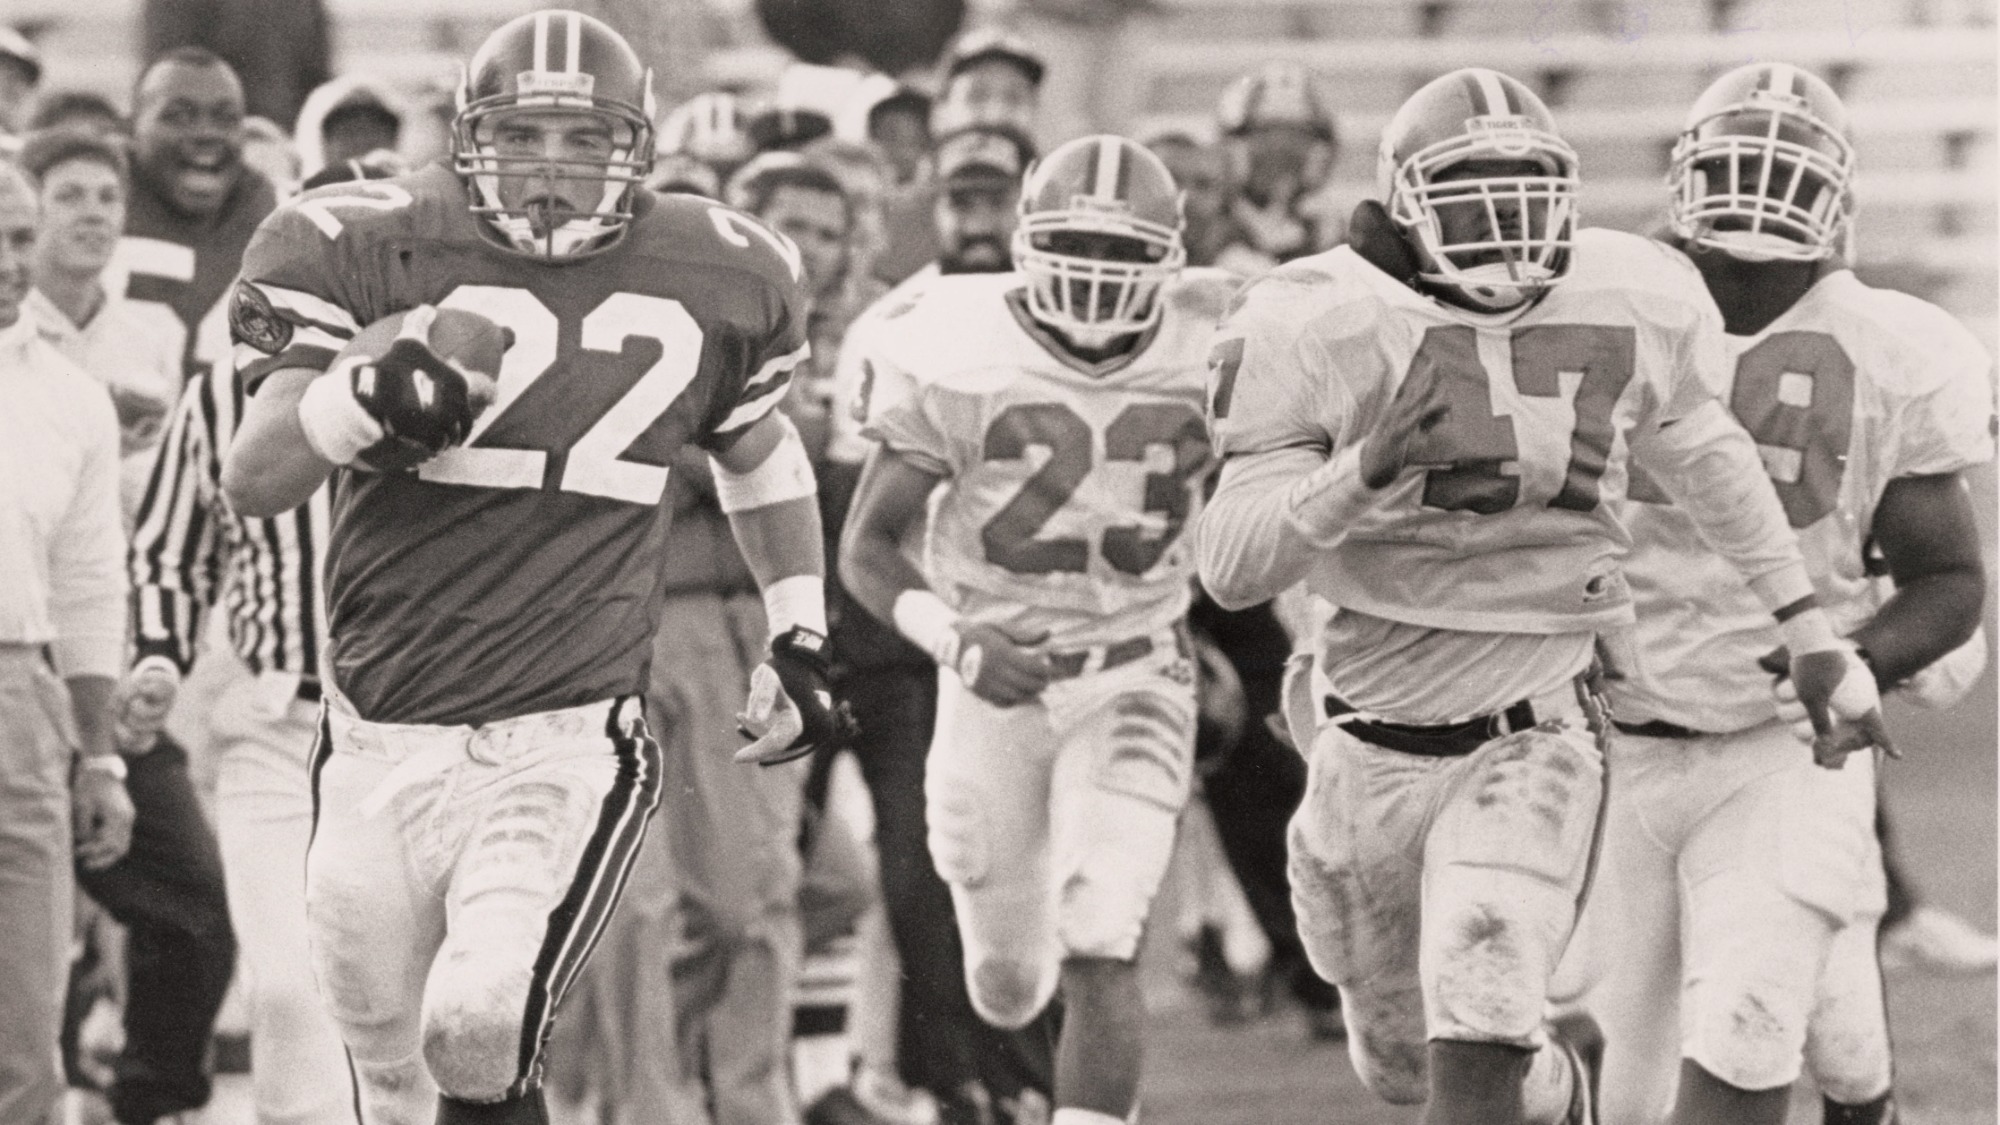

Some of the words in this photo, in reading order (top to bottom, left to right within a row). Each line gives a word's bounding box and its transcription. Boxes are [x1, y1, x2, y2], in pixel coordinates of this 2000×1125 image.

[1486, 121, 1519, 130] TIGERS
[418, 284, 704, 505] 22
[1397, 324, 1636, 515] 47
[981, 402, 1210, 575] 23
